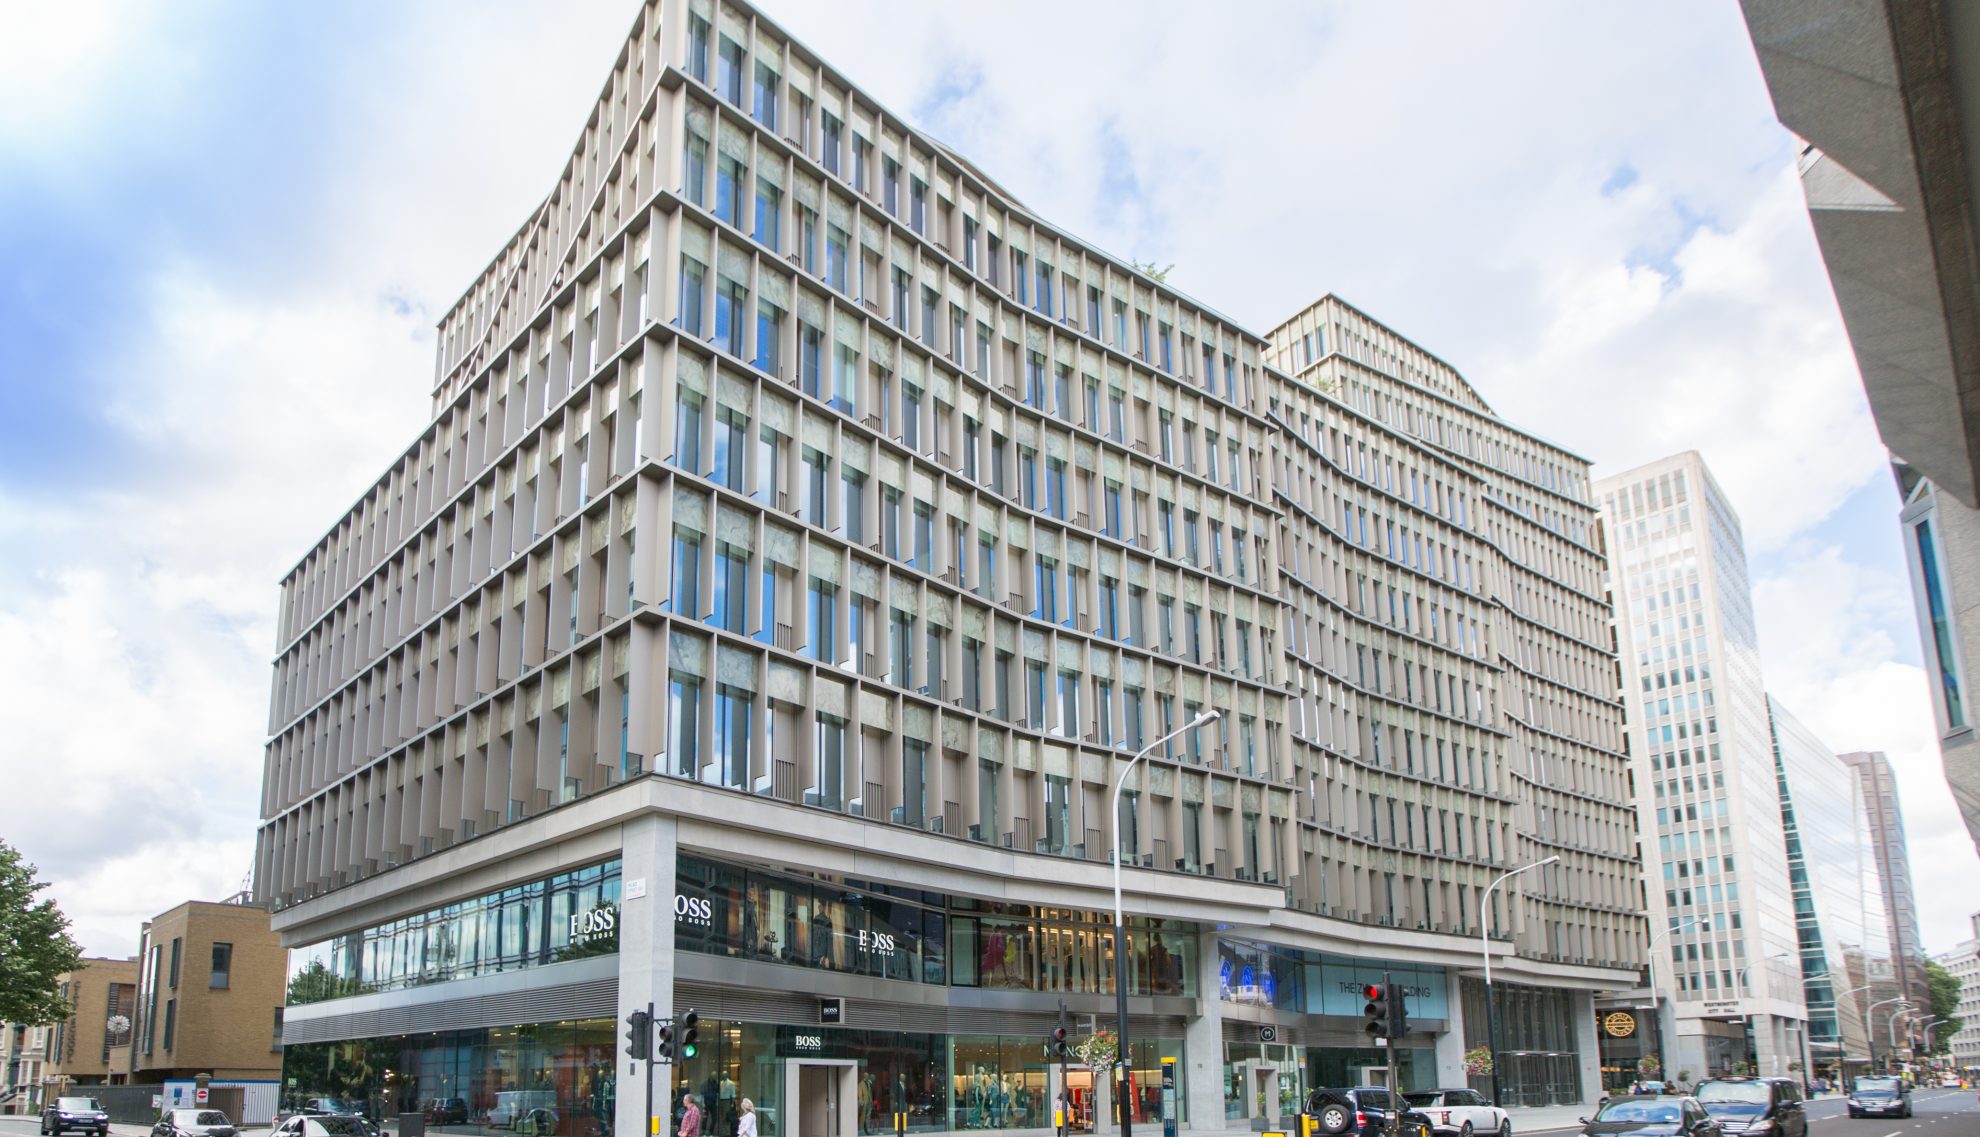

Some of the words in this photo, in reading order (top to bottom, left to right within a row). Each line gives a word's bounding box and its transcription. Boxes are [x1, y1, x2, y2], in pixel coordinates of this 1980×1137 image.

[674, 894, 712, 919] OSS
[1339, 982, 1355, 994] THE
[795, 1035, 821, 1047] BOSS
[1043, 1045, 1086, 1057] MNG
